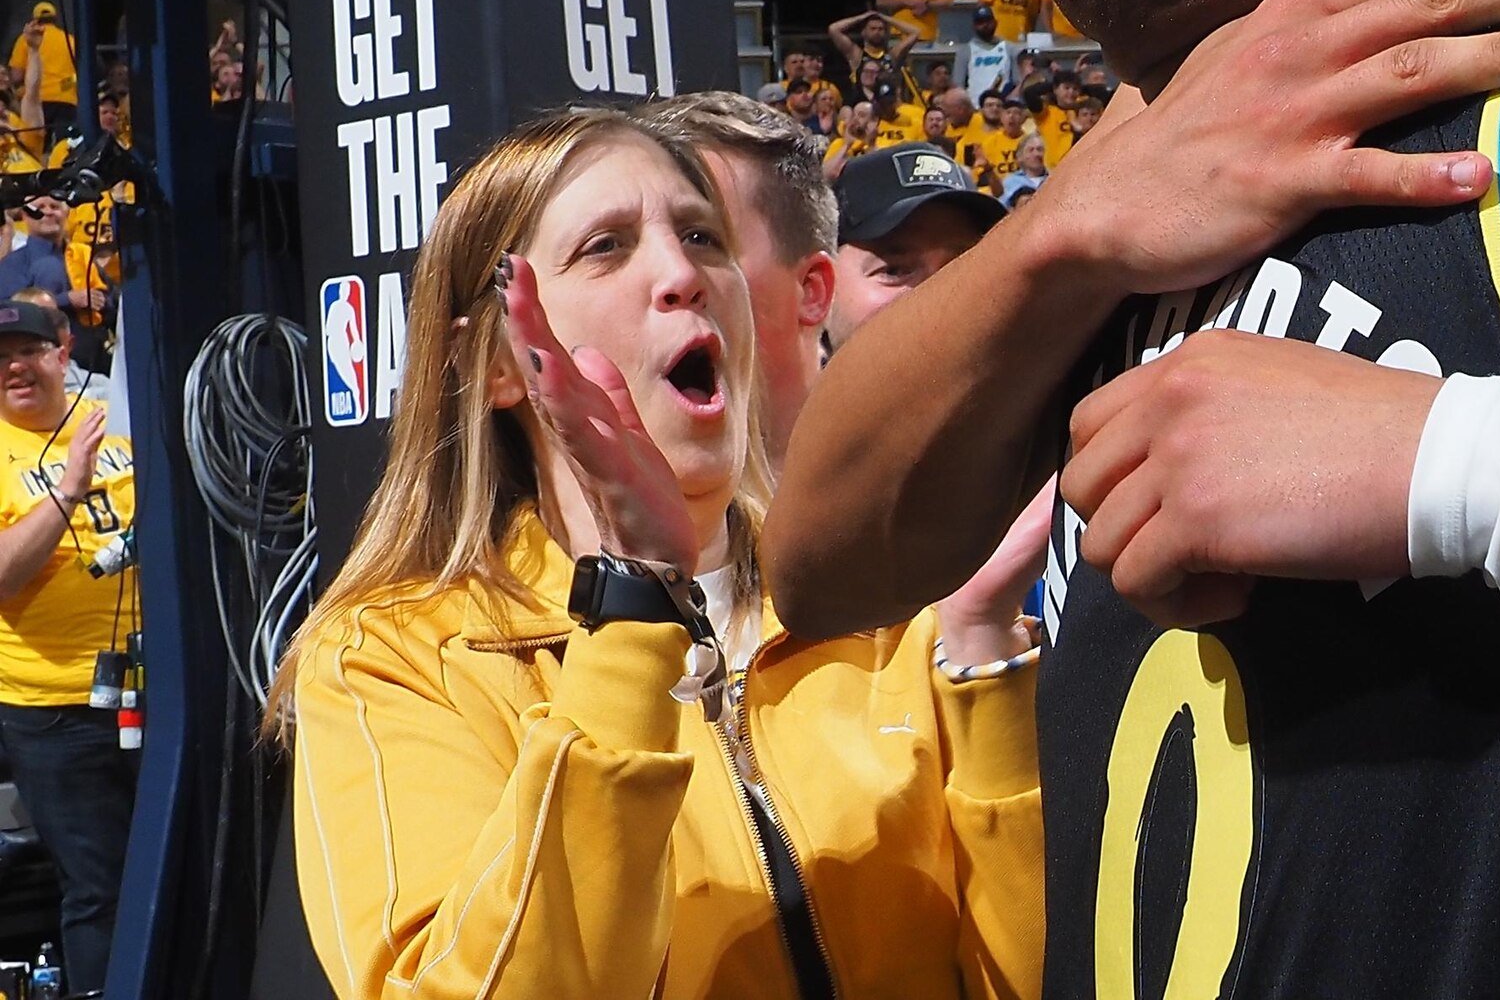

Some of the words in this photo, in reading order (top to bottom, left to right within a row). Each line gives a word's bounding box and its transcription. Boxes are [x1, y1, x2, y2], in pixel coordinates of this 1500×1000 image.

[337, 104, 451, 258] THE
[331, 391, 353, 416] NBA
[1094, 628, 1254, 1000] 0
